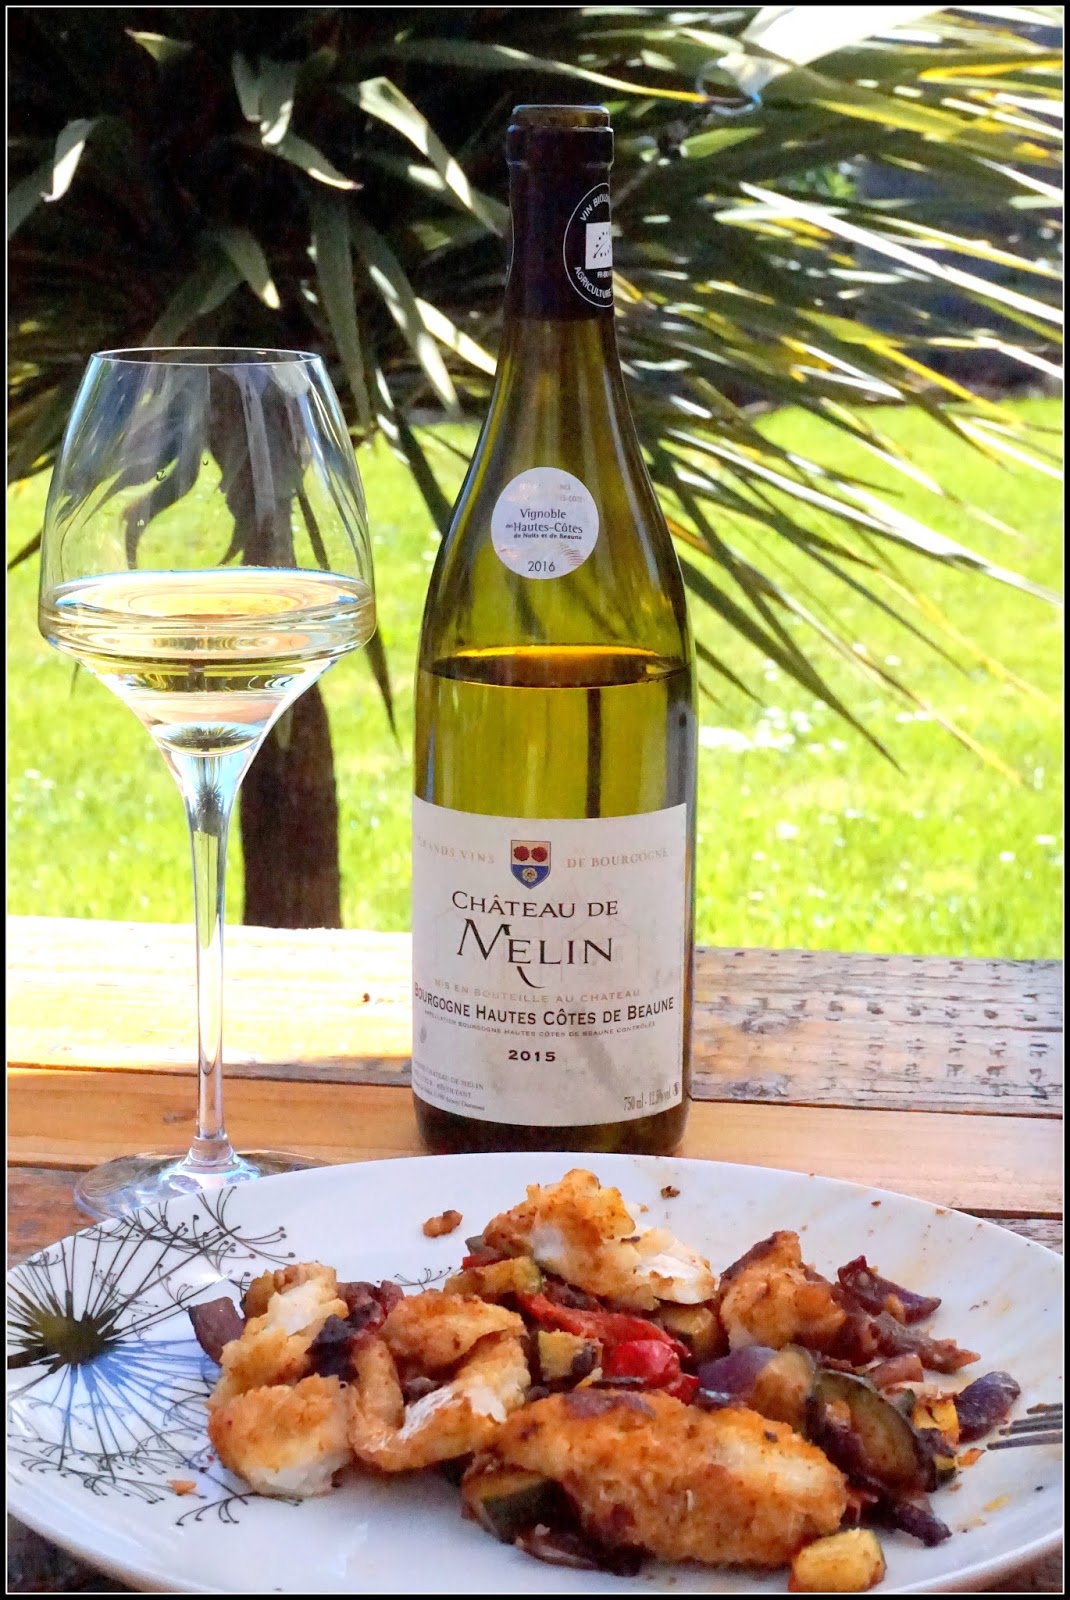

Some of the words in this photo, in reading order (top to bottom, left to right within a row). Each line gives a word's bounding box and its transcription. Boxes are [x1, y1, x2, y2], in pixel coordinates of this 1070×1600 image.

[580, 204, 593, 221] VIN
[520, 508, 567, 520] Vignoble
[513, 522, 583, 534] Hautes-Côtes
[528, 560, 556, 572] 2016
[460, 849, 495, 864] VINS
[567, 858, 586, 868] DE
[591, 847, 669, 867] BOURGOGNE
[452, 890, 575, 918] CHÂTEAU
[587, 900, 618, 916] DE
[456, 918, 612, 989] MELIN
[434, 979, 450, 990] MIS
[454, 985, 469, 994] EN
[474, 988, 549, 1003] BOUTEILLE
[555, 995, 574, 1003] AU
[414, 982, 470, 1017] BOURGOGNE
[476, 1004, 536, 1025] HAUTES
[543, 1008, 596, 1026] CÔTES
[602, 1009, 621, 1024] DE
[627, 996, 674, 1020] BEAUNE
[458, 1021, 501, 1034] BOURGOGNE
[504, 1029, 536, 1037] HAUTES
[582, 1028, 614, 1037] BEAUNE
[508, 1049, 556, 1062] 2015
